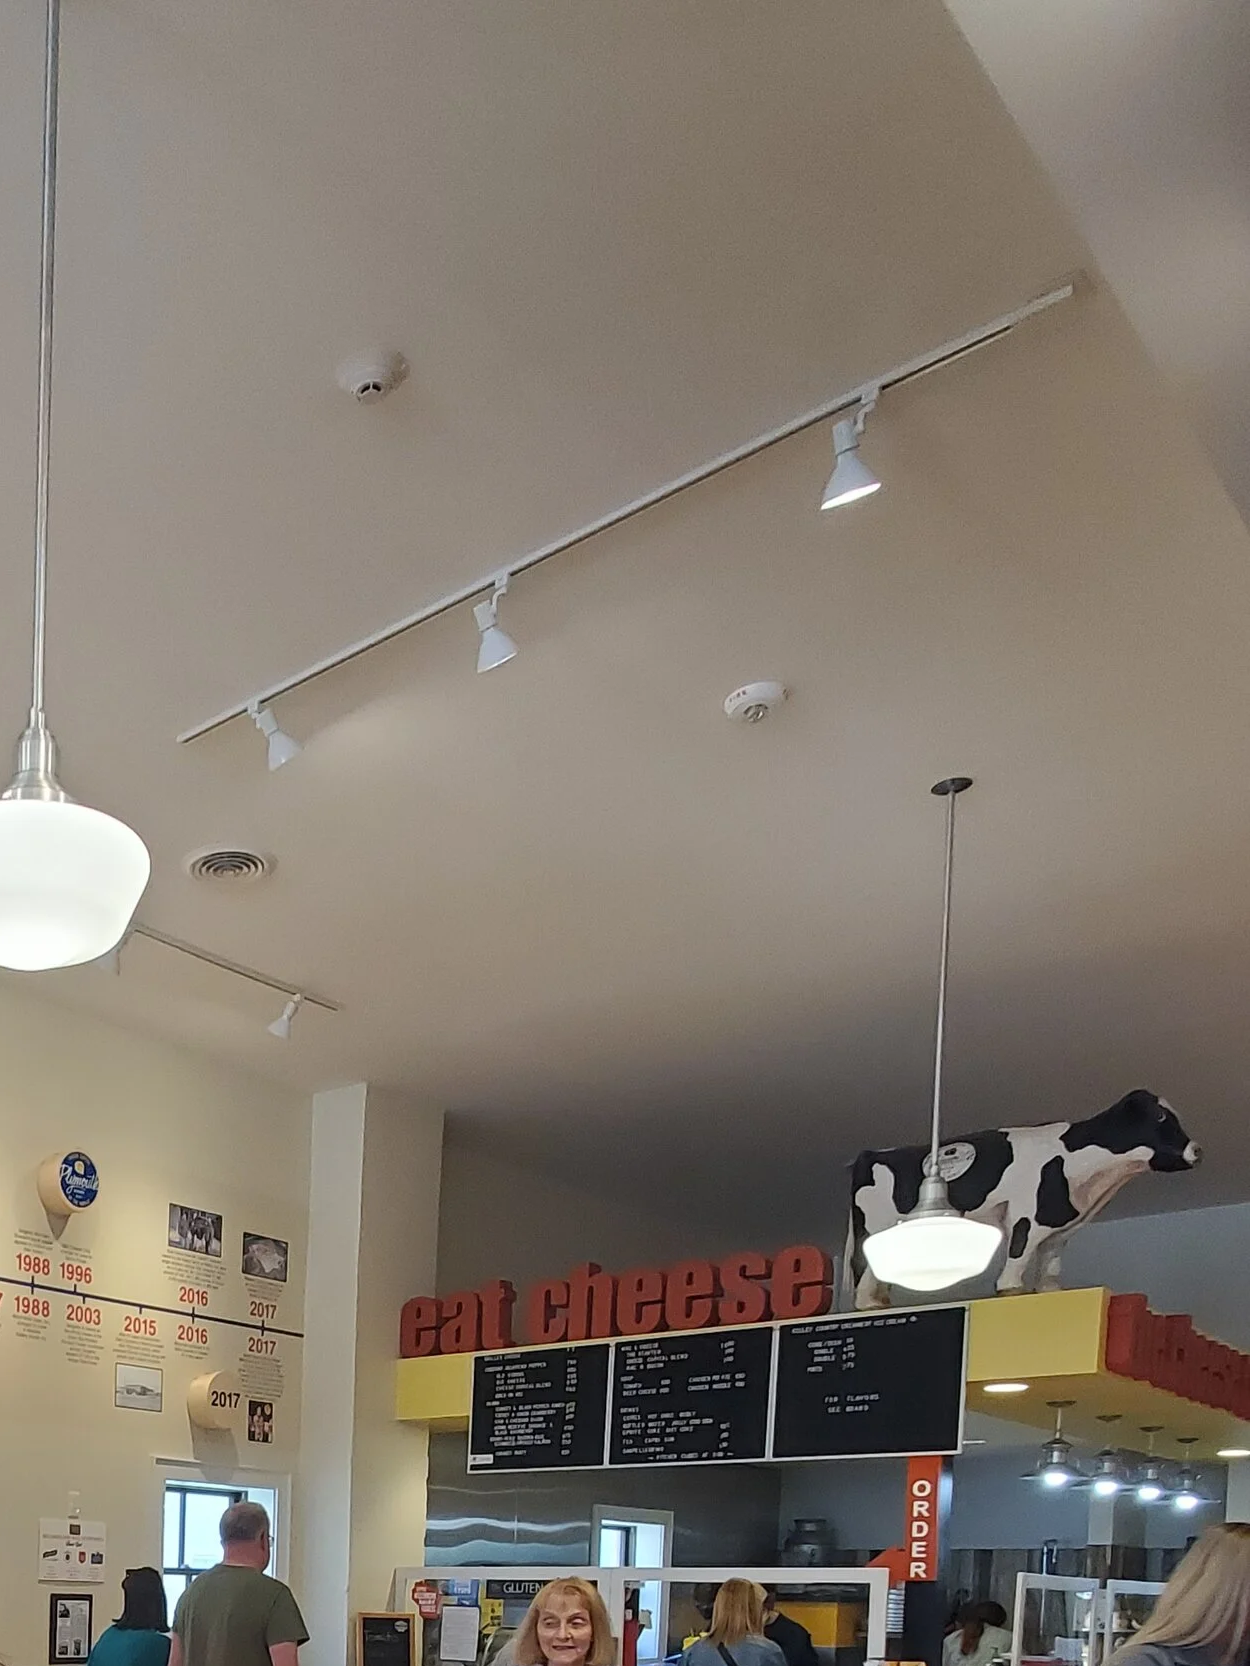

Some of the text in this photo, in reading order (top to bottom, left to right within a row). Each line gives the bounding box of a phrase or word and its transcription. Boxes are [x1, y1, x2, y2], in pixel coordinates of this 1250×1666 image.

[15, 1252, 51, 1276] 1988
[59, 1262, 92, 1284] 1996
[179, 1286, 208, 1307] 2016
[401, 1244, 833, 1358] eat cheese
[14, 1296, 50, 1319] 1988
[66, 1304, 102, 1326] 2003
[250, 1301, 277, 1319] 2017
[124, 1316, 157, 1336] 2015
[177, 1325, 208, 1345] 2016
[248, 1337, 276, 1356] 2017
[211, 1390, 241, 1409] 2017
[909, 1480, 931, 1578] ORDER
[503, 1582, 544, 1594] GLUTEN
